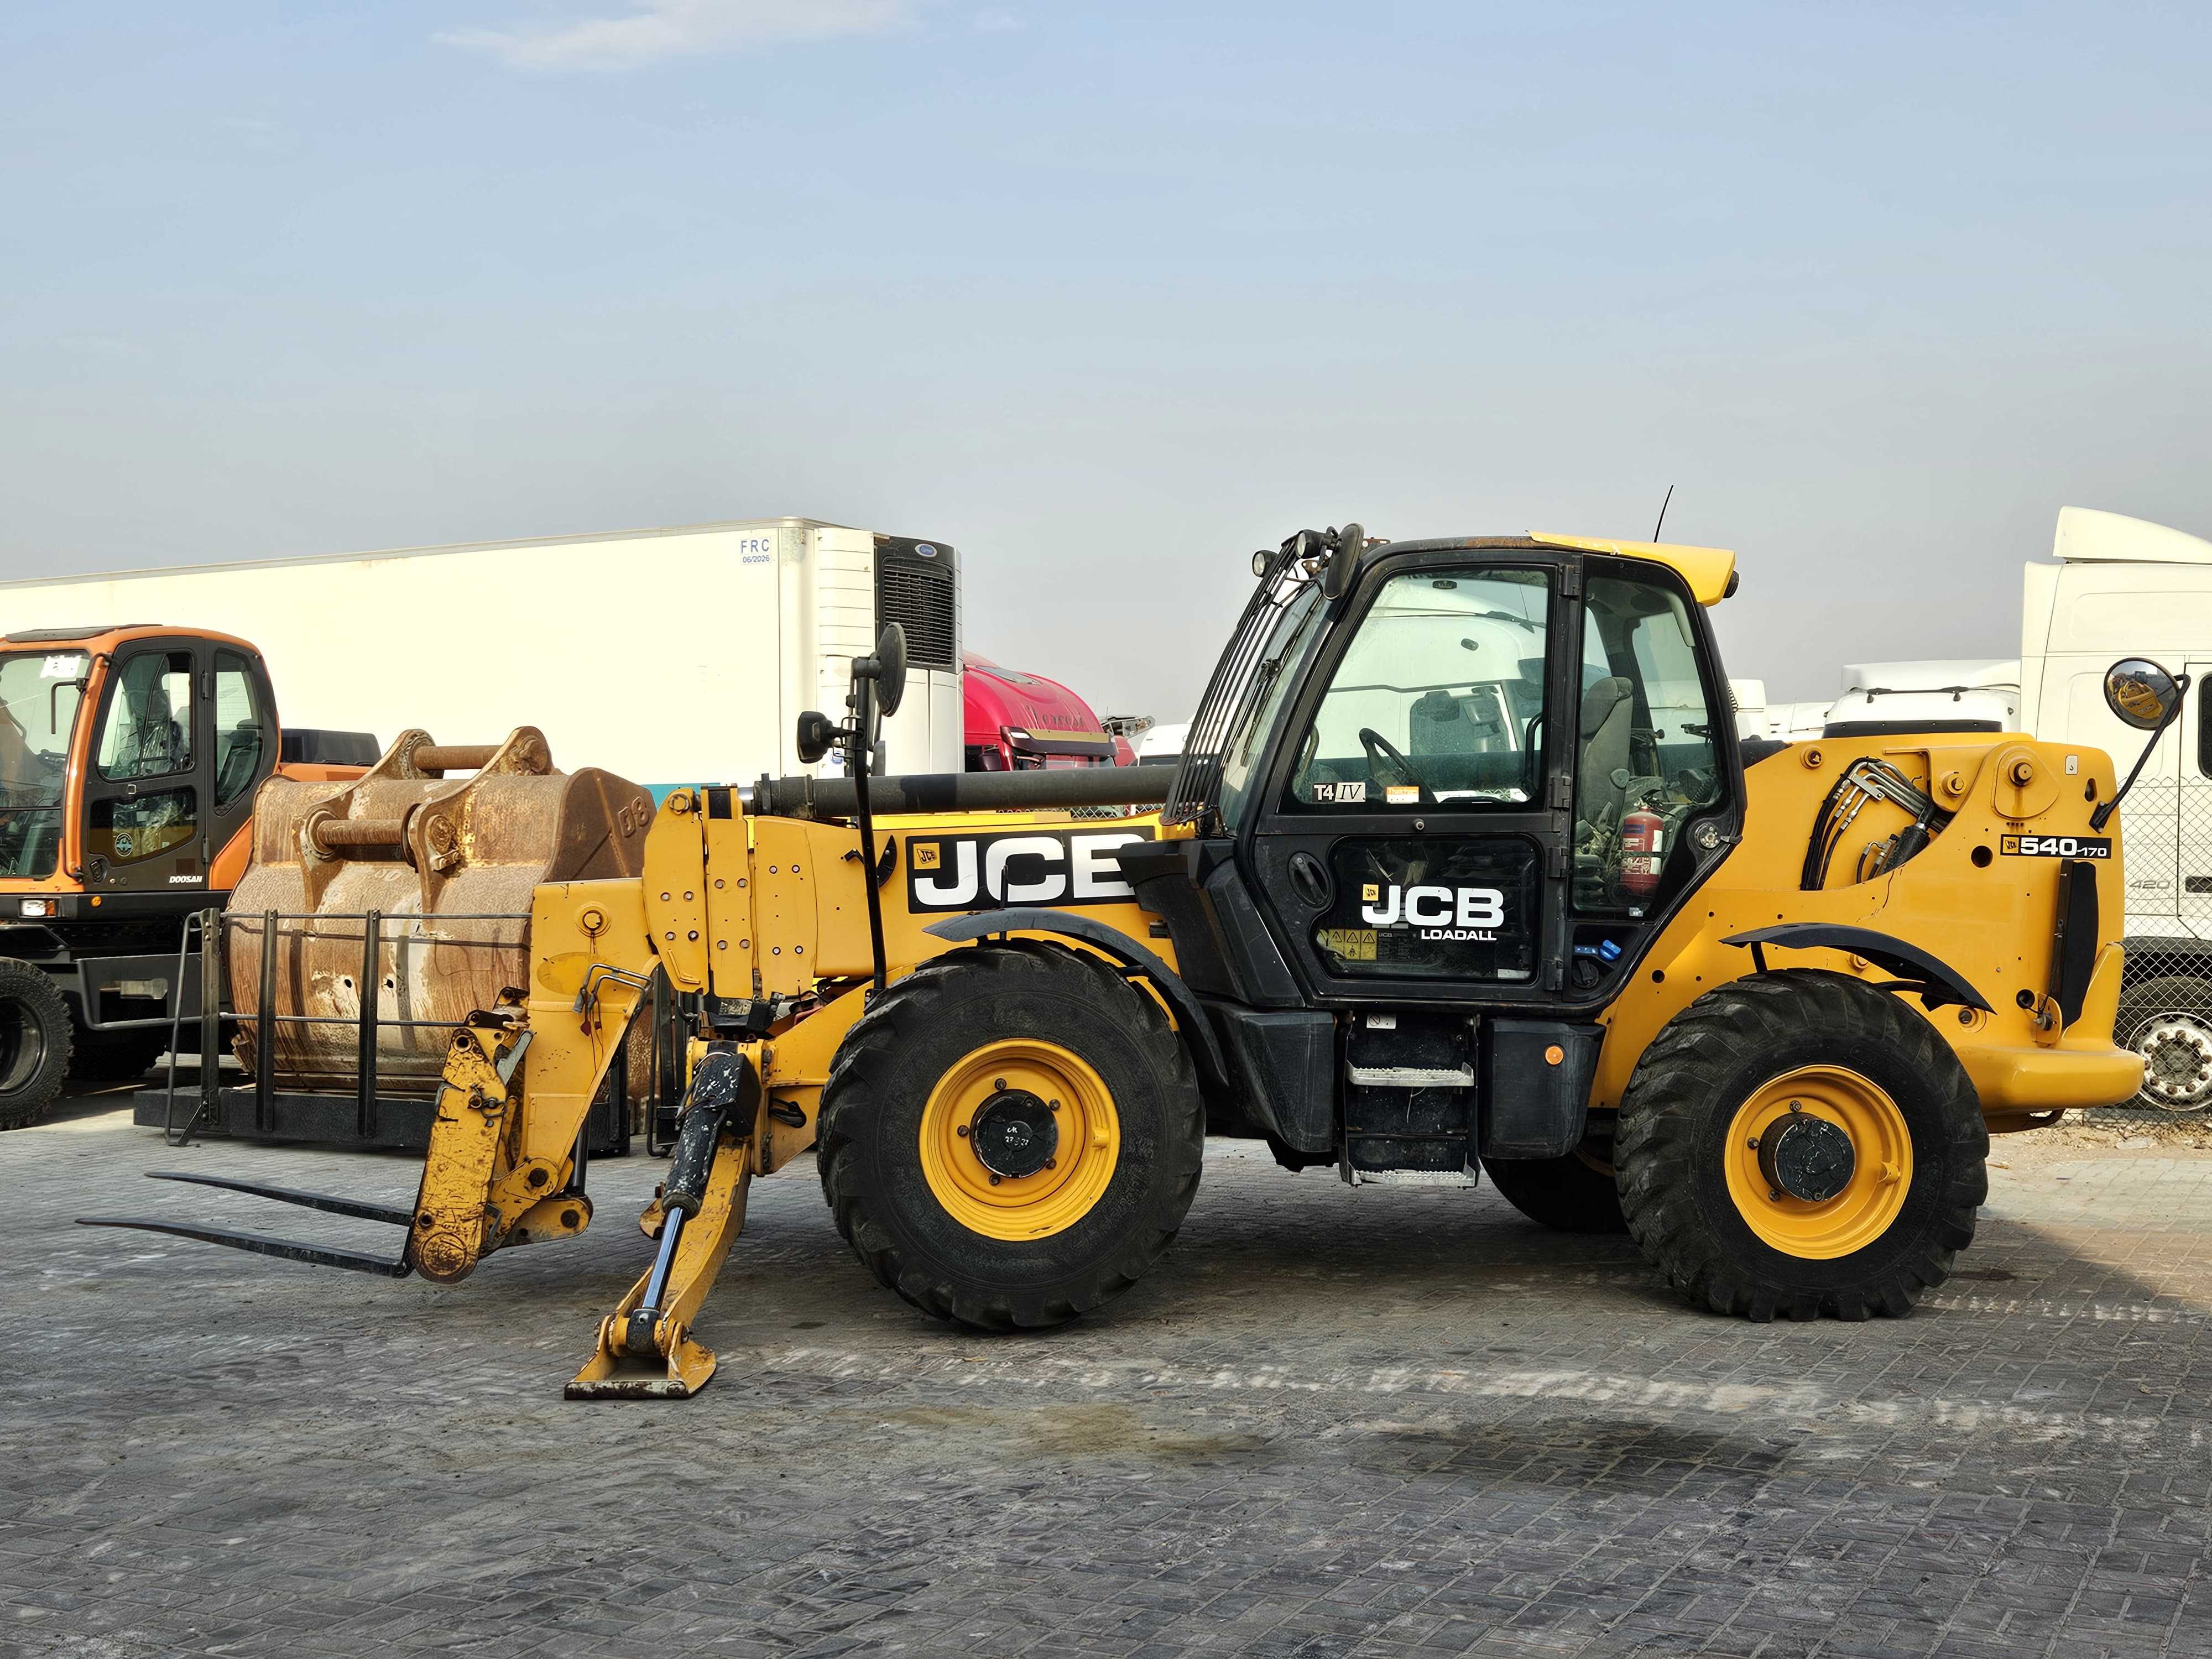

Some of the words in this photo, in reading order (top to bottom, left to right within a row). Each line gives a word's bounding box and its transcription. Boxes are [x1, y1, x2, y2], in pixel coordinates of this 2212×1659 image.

[741, 539, 769, 553] FRC
[743, 555, 770, 563] 06/2026
[1313, 784, 1334, 801] T4
[1339, 785, 1361, 800] IV
[2020, 837, 2107, 857] 540-170
[169, 875, 202, 884] DOOSAN
[2130, 880, 2170, 889] 420
[1362, 885, 1504, 927] JCB
[1421, 929, 1497, 941] LOADALL
